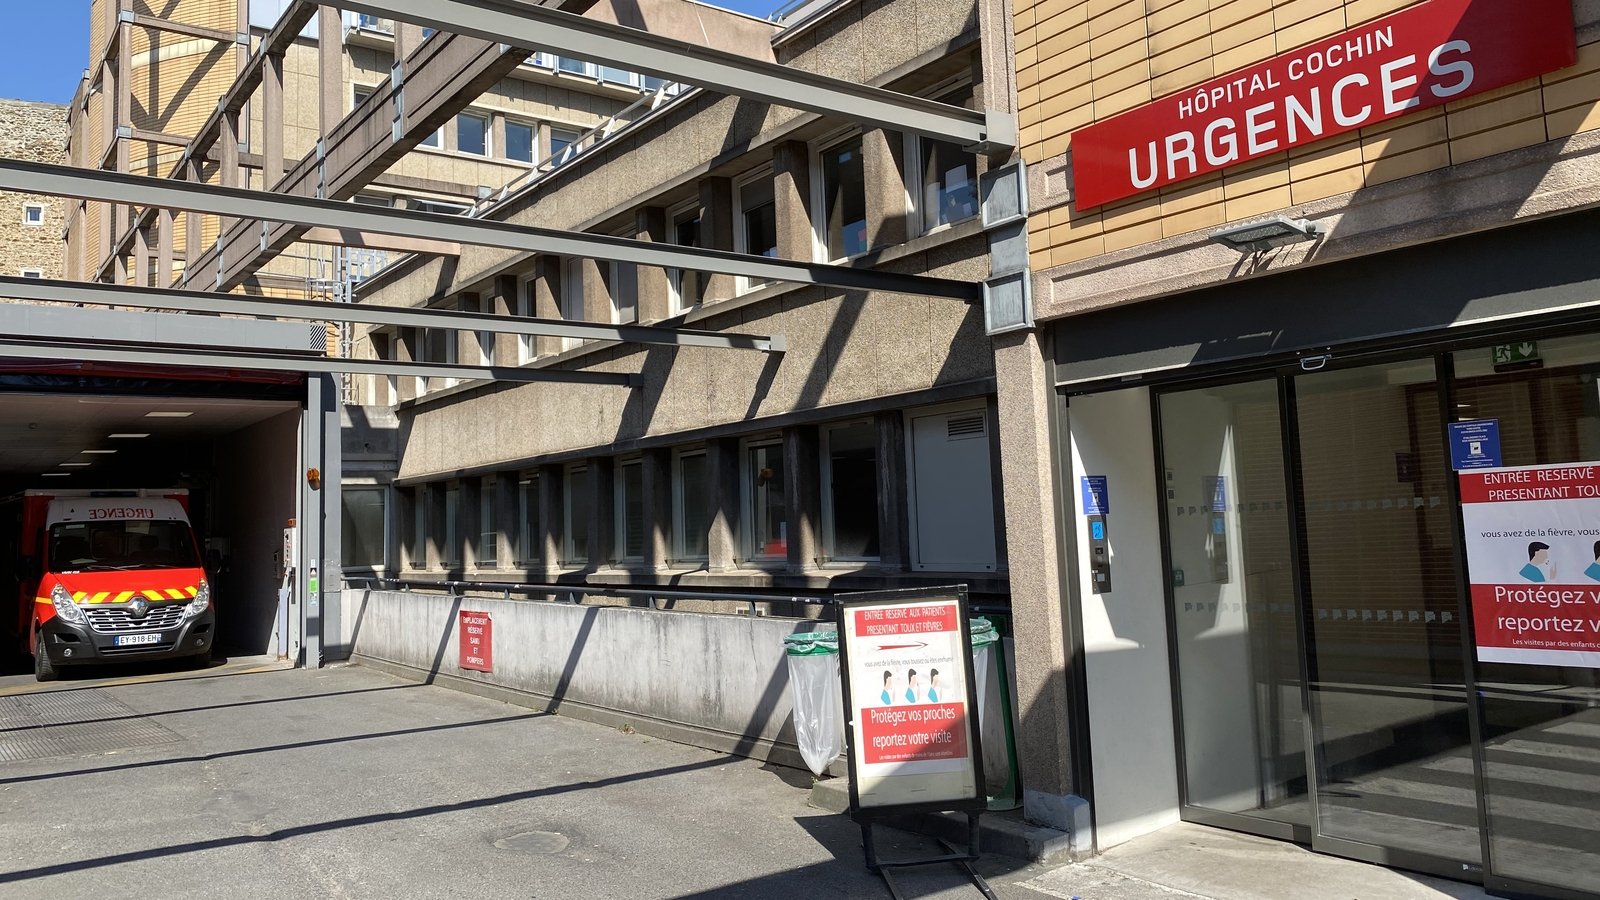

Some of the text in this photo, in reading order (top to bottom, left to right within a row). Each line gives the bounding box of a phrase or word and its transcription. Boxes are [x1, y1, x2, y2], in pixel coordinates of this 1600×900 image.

[1178, 25, 1393, 120] HÔPITAL COCHIN
[1128, 39, 1475, 190] URGENCES
[1484, 466, 1594, 484] ENTRÉE RESERVÉ
[1489, 486, 1570, 501] PRESENTANT
[1481, 530, 1501, 538] vous
[1525, 529, 1536, 537] de
[1537, 528, 1546, 536] la
[1547, 527, 1575, 537] fièvre,
[1494, 586, 1586, 608] Protégez
[864, 609, 884, 620] ENTRÉE
[909, 607, 921, 618] AUX
[922, 606, 945, 617] PATIENTS
[866, 624, 899, 635] PRESENTANT
[900, 623, 915, 633] TOUX
[915, 622, 922, 632] ET
[1498, 616, 1585, 634] reportez
[120, 634, 157, 644] EY-918-EH
[1557, 639, 1569, 647] des
[1570, 640, 1595, 648] enfants
[871, 705, 956, 727] Protégez vos proches
[872, 729, 952, 751] reportez votre visite
